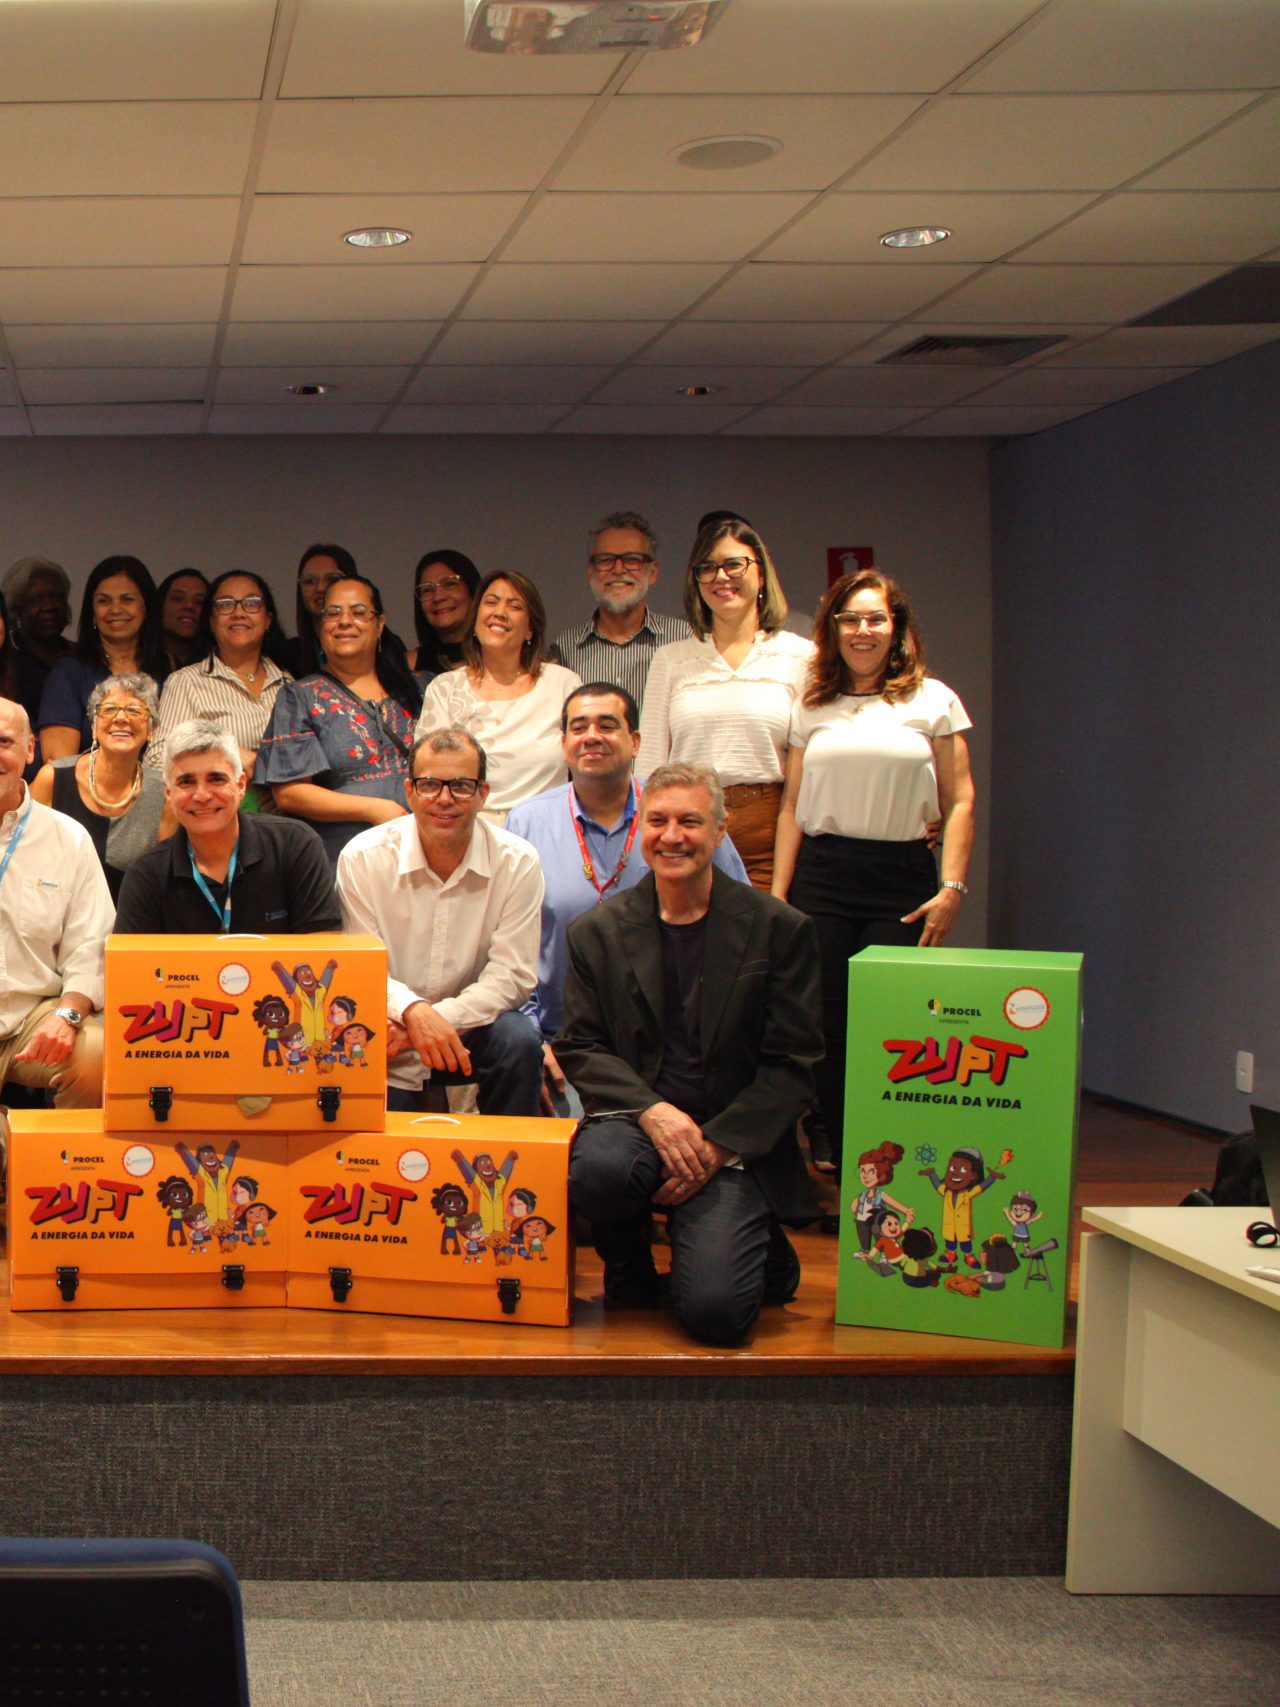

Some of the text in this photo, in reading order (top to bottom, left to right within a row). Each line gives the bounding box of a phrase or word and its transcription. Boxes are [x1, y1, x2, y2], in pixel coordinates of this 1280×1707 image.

[118, 997, 239, 1044] ZUPT
[943, 1007, 982, 1017] PROCEL
[125, 1050, 230, 1059] A ENERGIA DA VIDA
[882, 1035, 1029, 1087] ZUPT
[882, 1090, 1022, 1109] A ENERGIA DA VIDA
[348, 1157, 380, 1166] PROCEL
[25, 1179, 144, 1226] ZUPT
[299, 1182, 418, 1227] ZUPT
[31, 1231, 135, 1240] A ENERGIA DA VIDA
[305, 1230, 408, 1245] A ENERGIA DA VIDA
